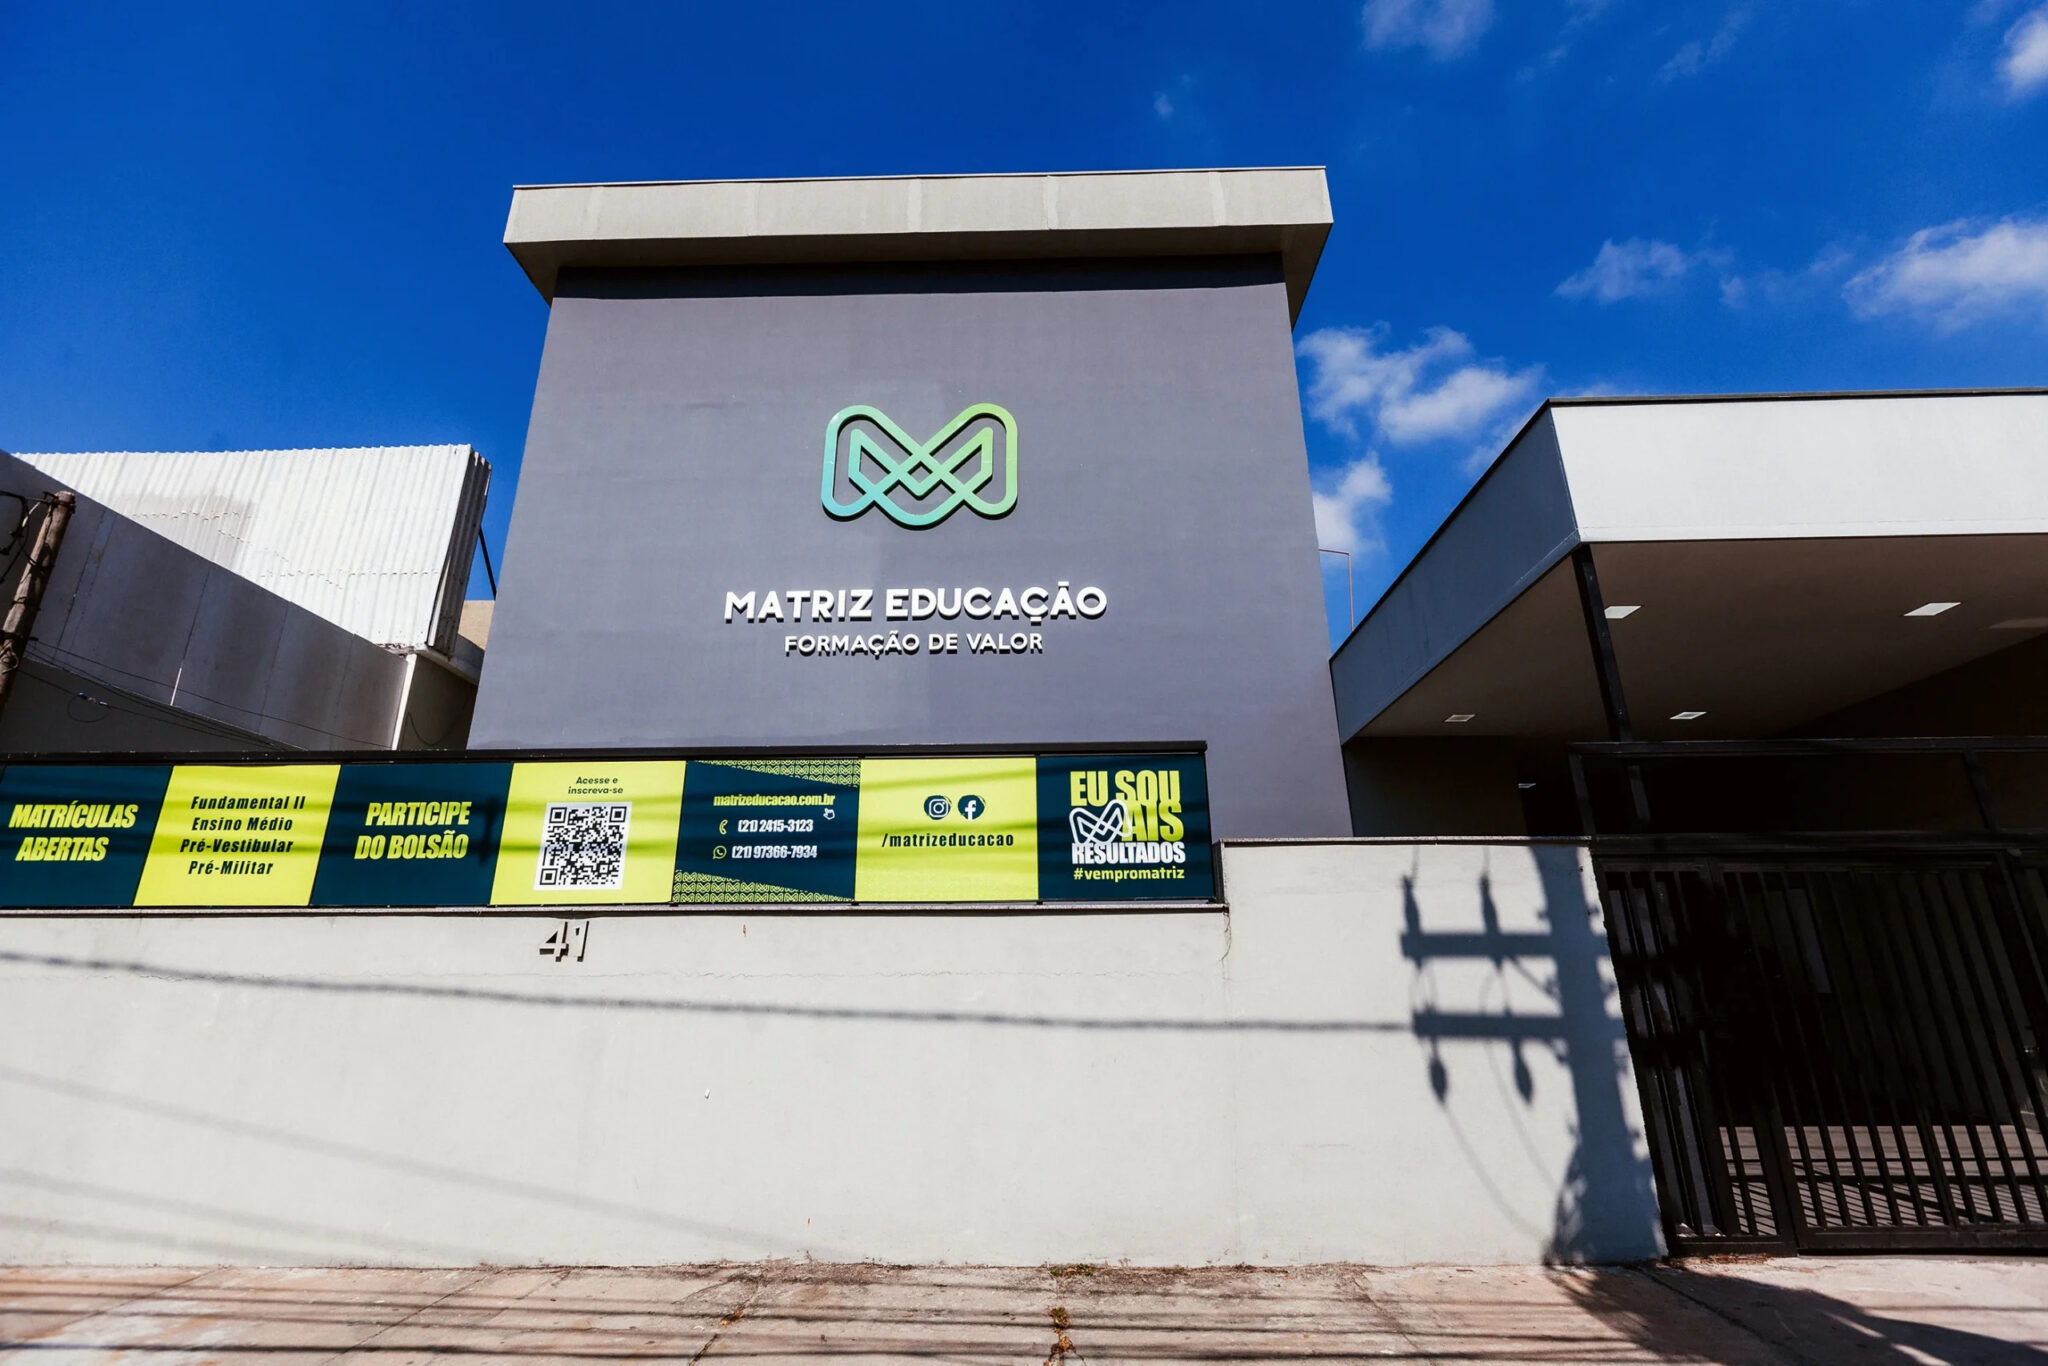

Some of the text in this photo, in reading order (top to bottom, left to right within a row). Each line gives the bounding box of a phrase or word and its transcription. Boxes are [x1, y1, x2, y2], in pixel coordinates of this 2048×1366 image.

[724, 581, 1108, 626] MATRIZ EDUCAÇÃO
[784, 630, 1043, 659] FORMAÇÃO DE VALOR
[576, 776, 610, 784] Acesse
[1070, 769, 1181, 807] EU SOU
[568, 786, 623, 794] inscreva-se
[190, 796, 288, 810] Fundamental
[713, 793, 835, 806] matrizeducacao.com.br
[8, 800, 139, 829] MATRÍCULAS
[364, 801, 472, 826] PARTICIPE
[192, 816, 294, 831] Ensino Médio
[738, 819, 814, 832] (21) 2415-3123
[180, 838, 294, 853] Pré-Vestibular
[354, 830, 469, 860] DO BOLSÃO
[881, 832, 1015, 848] /matrizeducacao
[15, 836, 110, 862] ABERTAS
[731, 845, 818, 859] (21) 97366-7934
[1072, 841, 1186, 864] RESULTADOS
[188, 861, 274, 875] Pré-Militar
[1073, 866, 1185, 882] #vempromatriz
